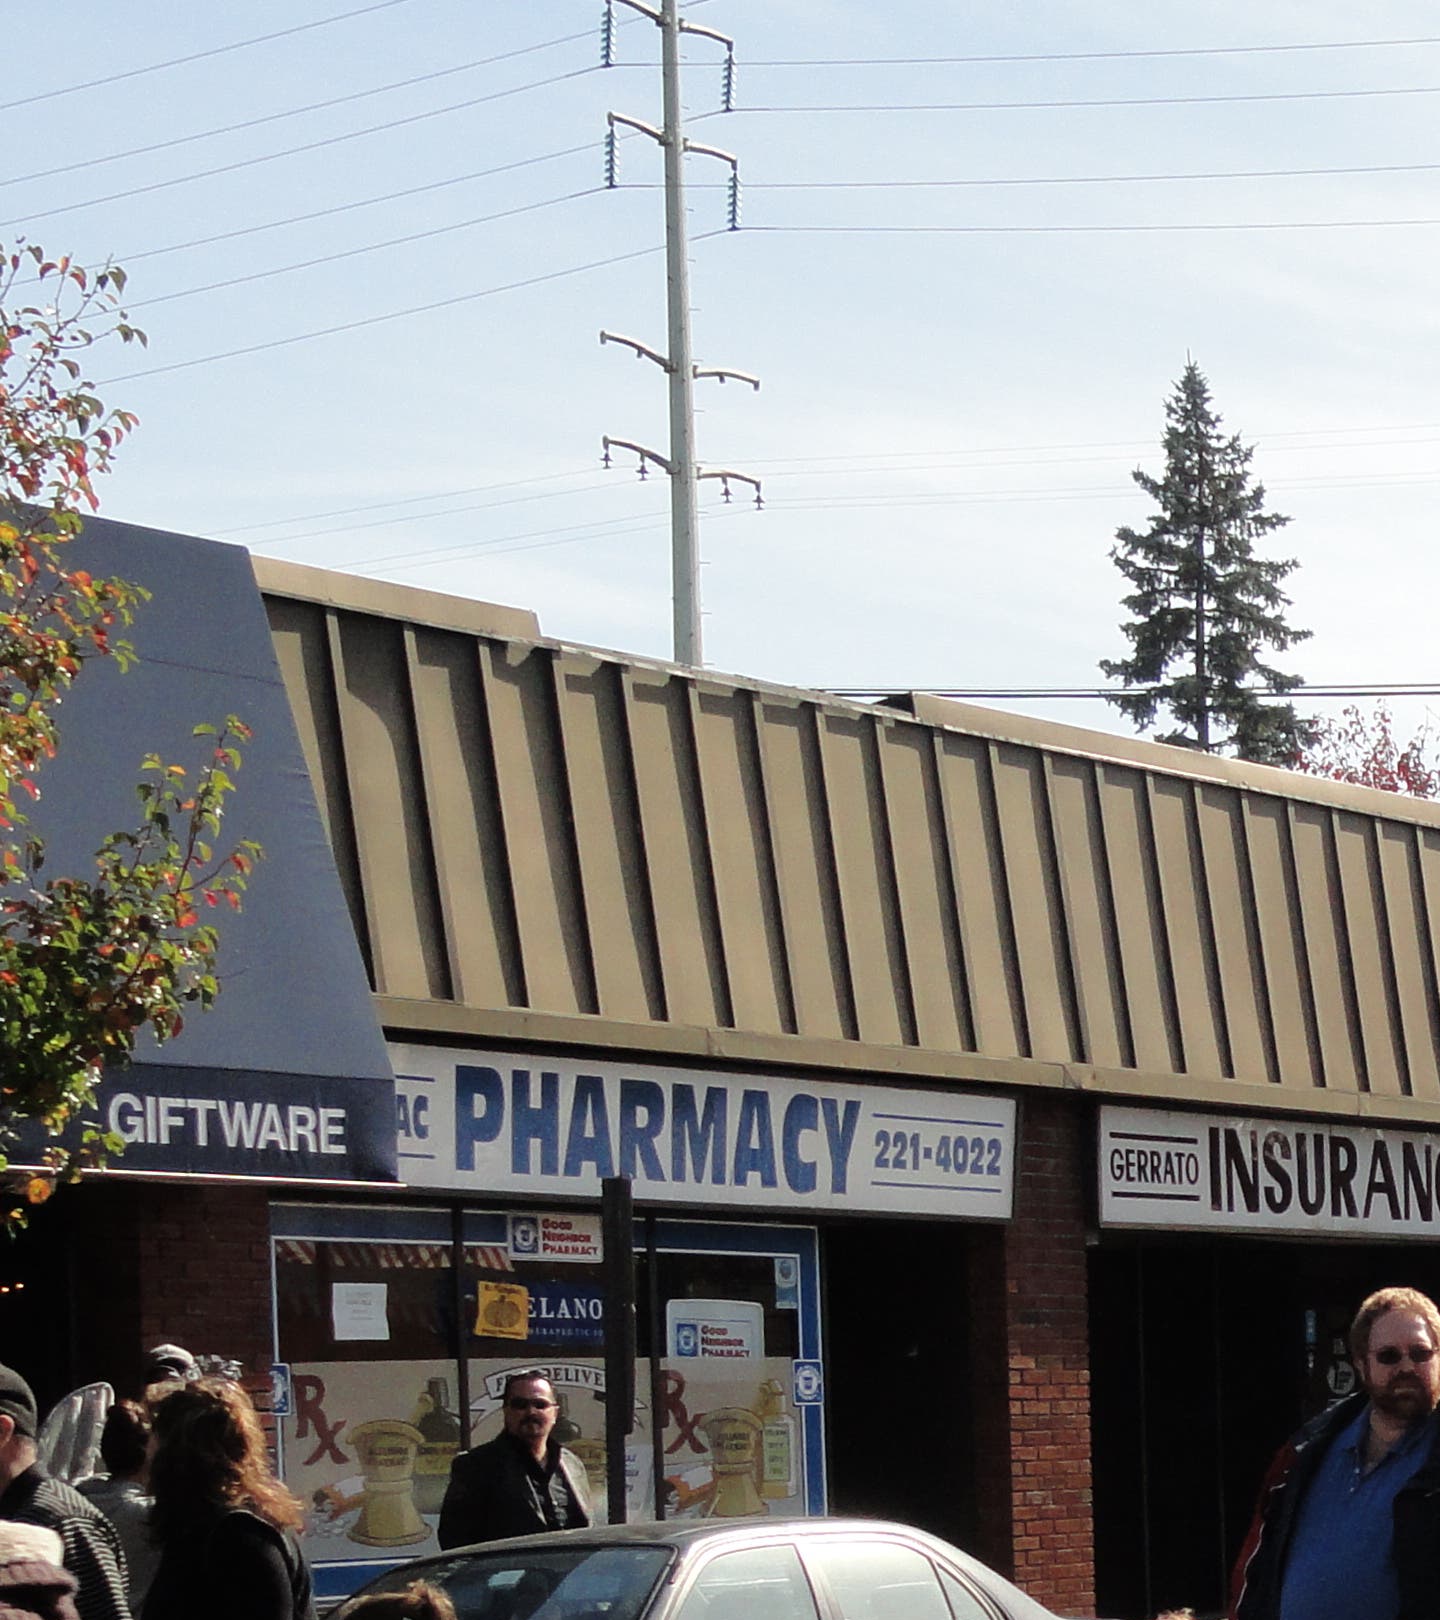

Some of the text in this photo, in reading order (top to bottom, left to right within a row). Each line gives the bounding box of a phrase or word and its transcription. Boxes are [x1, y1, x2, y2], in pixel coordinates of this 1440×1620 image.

[108, 1092, 347, 1155] GIFTWARE
[454, 1064, 862, 1195] PHARMACY
[873, 1129, 1003, 1177] 221-4022
[1110, 1148, 1199, 1186] GERRATO
[541, 1218, 573, 1231] GOOD
[541, 1230, 592, 1244] NEIGHBOR
[542, 1242, 600, 1256] PHARMACY
